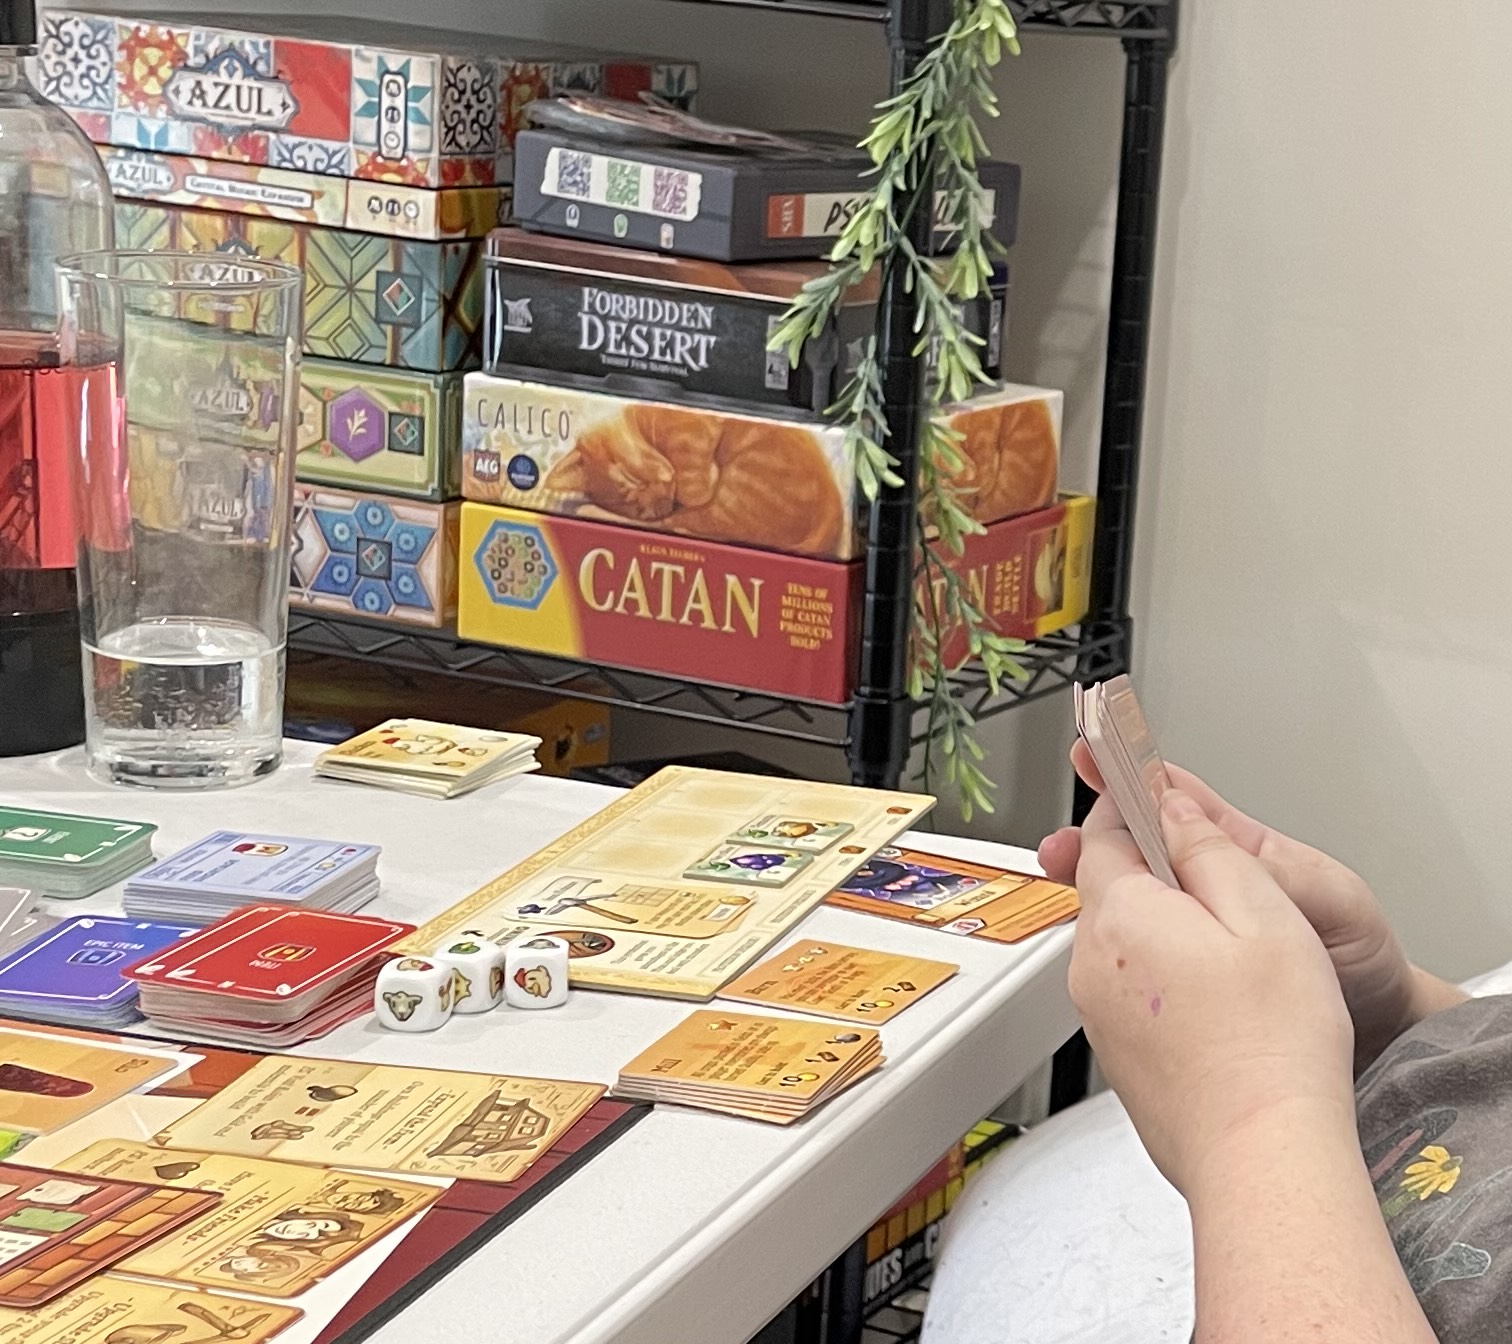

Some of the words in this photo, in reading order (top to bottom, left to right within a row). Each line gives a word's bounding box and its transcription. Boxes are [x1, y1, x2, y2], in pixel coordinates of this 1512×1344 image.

[187, 80, 274, 117] AZUL
[115, 163, 163, 185] AZUL
[200, 263, 255, 284] AZUL
[581, 286, 715, 329] FORBIDDEN
[577, 311, 717, 371] DESERT
[478, 399, 570, 441] CALICO
[578, 548, 765, 639] CATAN
[780, 594, 833, 614] MILLIONS
[83, 939, 113, 948] EPIC
[112, 941, 145, 951] ITEM
[852, 1001, 879, 1013] 10
[775, 1075, 804, 1087] 10
